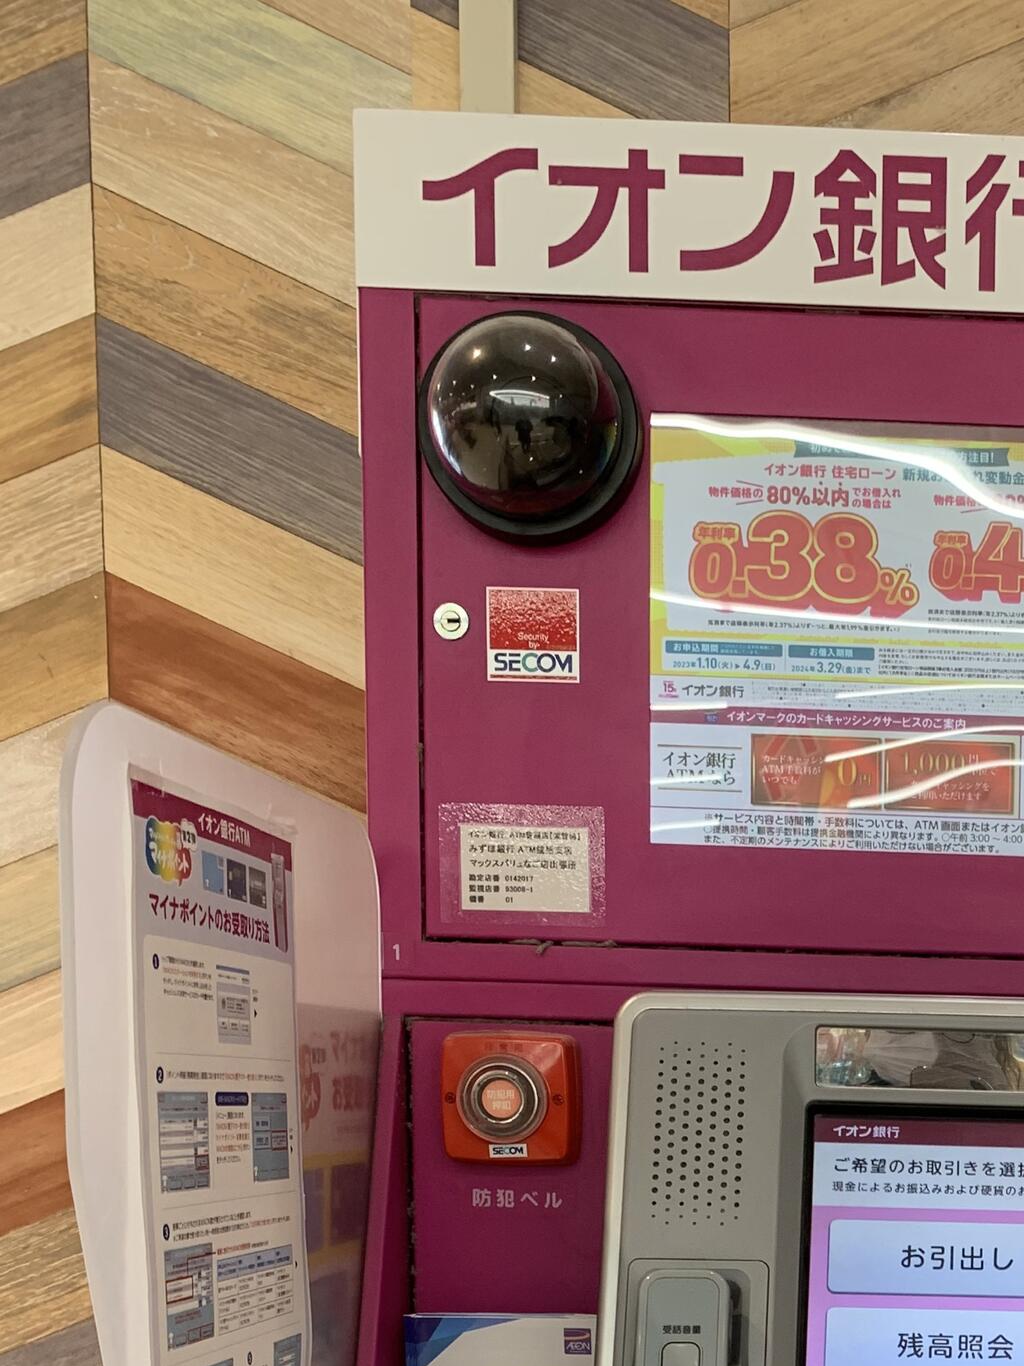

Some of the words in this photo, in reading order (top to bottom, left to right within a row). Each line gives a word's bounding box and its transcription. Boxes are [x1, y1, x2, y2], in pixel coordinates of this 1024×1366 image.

[764, 463, 826, 478] イオン銀行
[832, 465, 897, 480] 住宅ローン
[517, 632, 549, 642] Security
[493, 652, 573, 673] SECOM
[682, 683, 745, 699] イオン銀行
[726, 712, 967, 731] イオンマークのカードキャッシングサービスのご案内
[662, 751, 736, 769] イオン銀行
[149, 892, 271, 944] マイナポイントのお受取り方法
[392, 943, 400, 961] 1
[832, 1124, 900, 1139] イオン銀行
[492, 1146, 524, 1155] SECOM
[471, 1188, 563, 1208] 防犯ベル
[900, 1244, 1015, 1272] お引出し
[897, 1331, 1014, 1361] 残高照会
